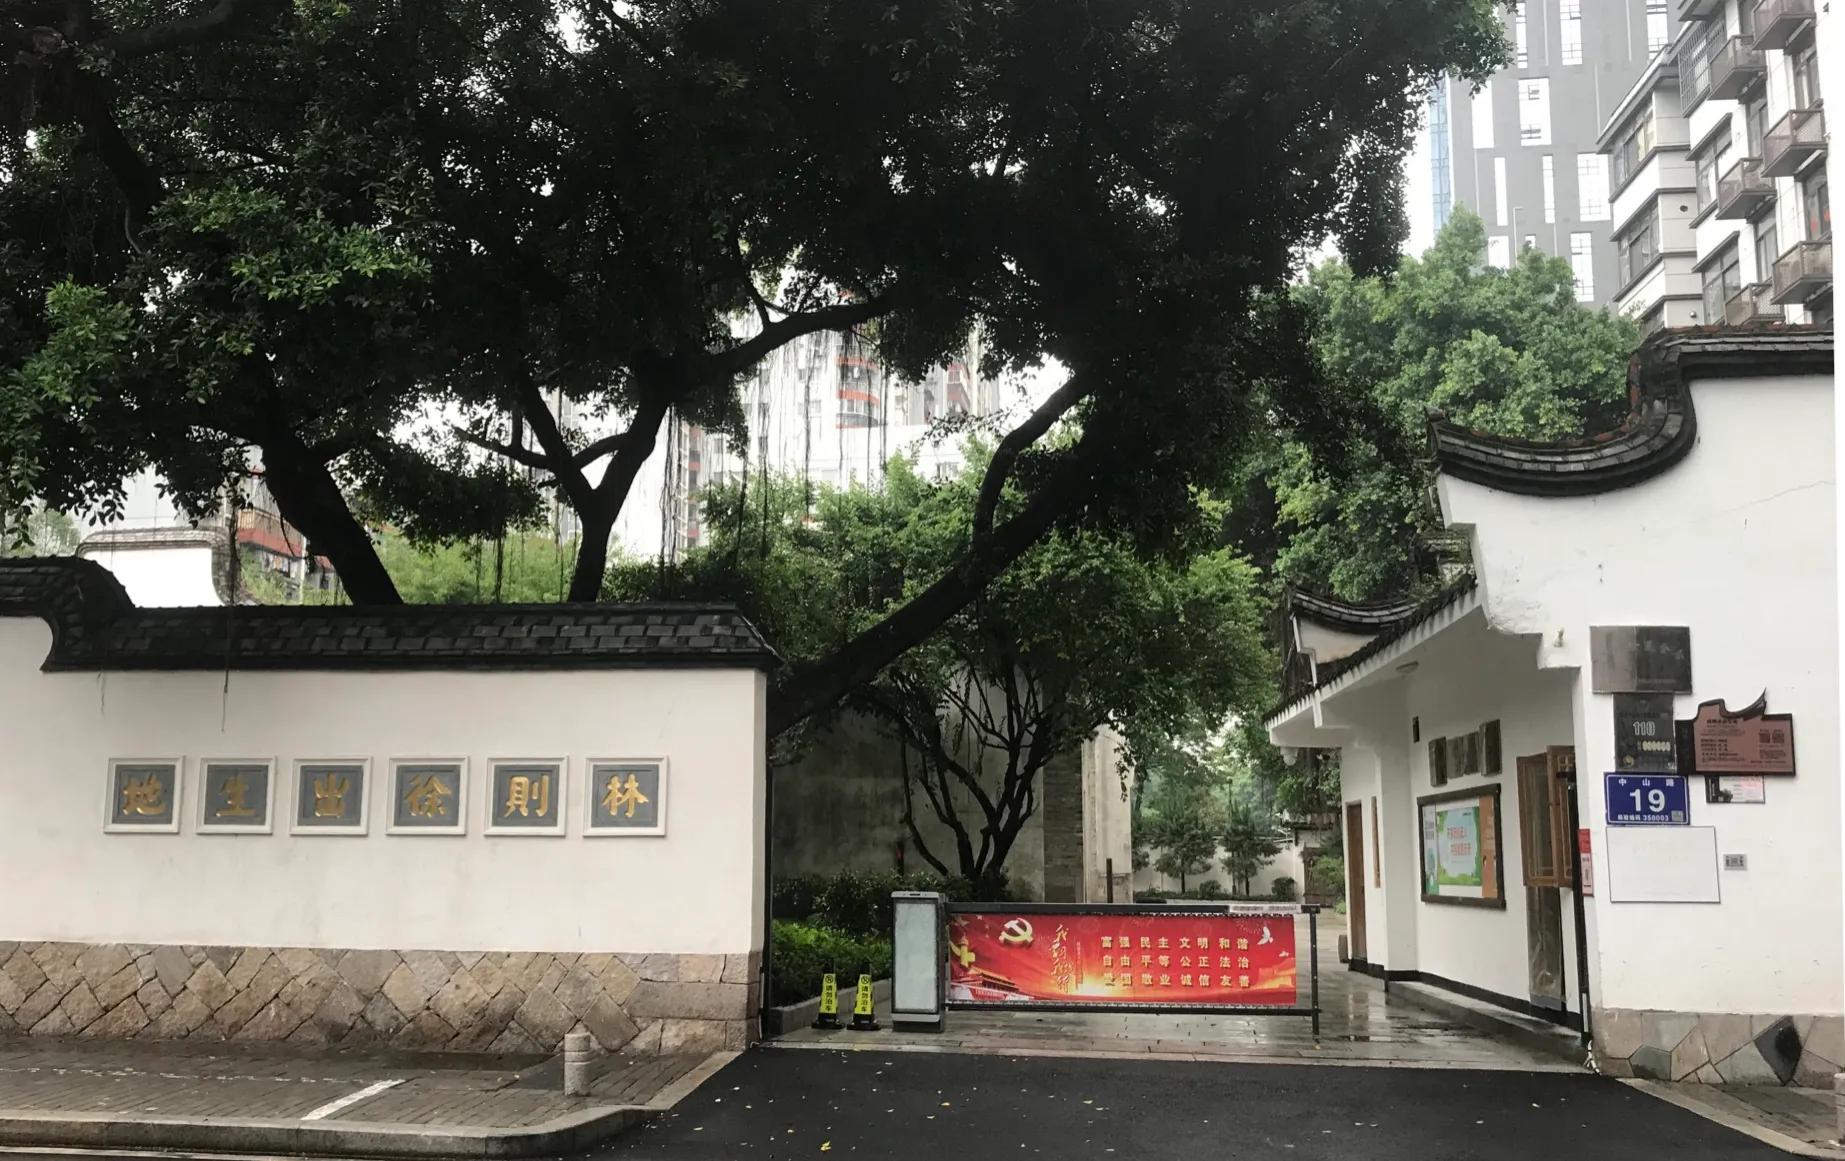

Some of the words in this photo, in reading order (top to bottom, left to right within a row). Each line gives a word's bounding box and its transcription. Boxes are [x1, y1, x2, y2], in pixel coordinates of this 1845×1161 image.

[1618, 778, 1675, 787] 中山路
[1629, 788, 1666, 813] 19
